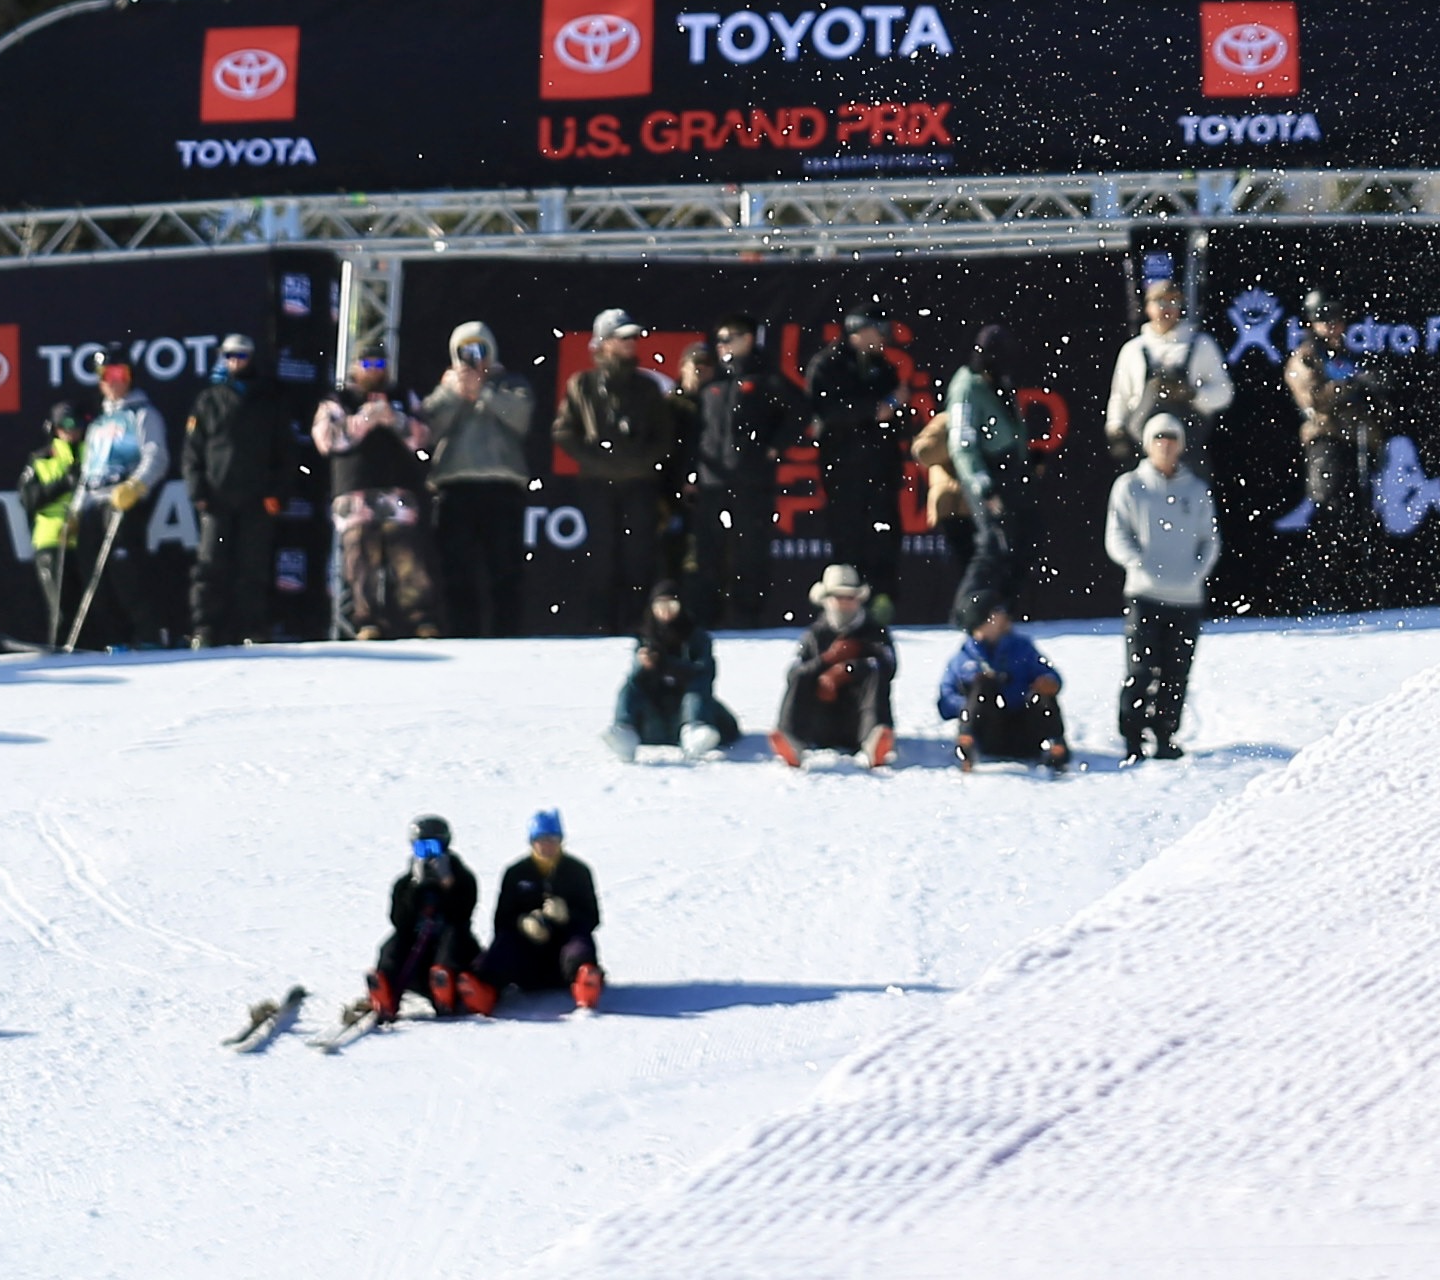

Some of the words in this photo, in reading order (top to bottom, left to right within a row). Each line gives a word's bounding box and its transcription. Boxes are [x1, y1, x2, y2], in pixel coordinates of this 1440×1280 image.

[676, 5, 955, 65] TOYOTA
[176, 136, 318, 168] TOYOTA
[538, 114, 631, 159] U.S.
[640, 106, 828, 152] GRAND
[837, 101, 953, 147] PRIX
[1176, 113, 1323, 145] TOYOTA
[38, 335, 218, 387] TOOT
